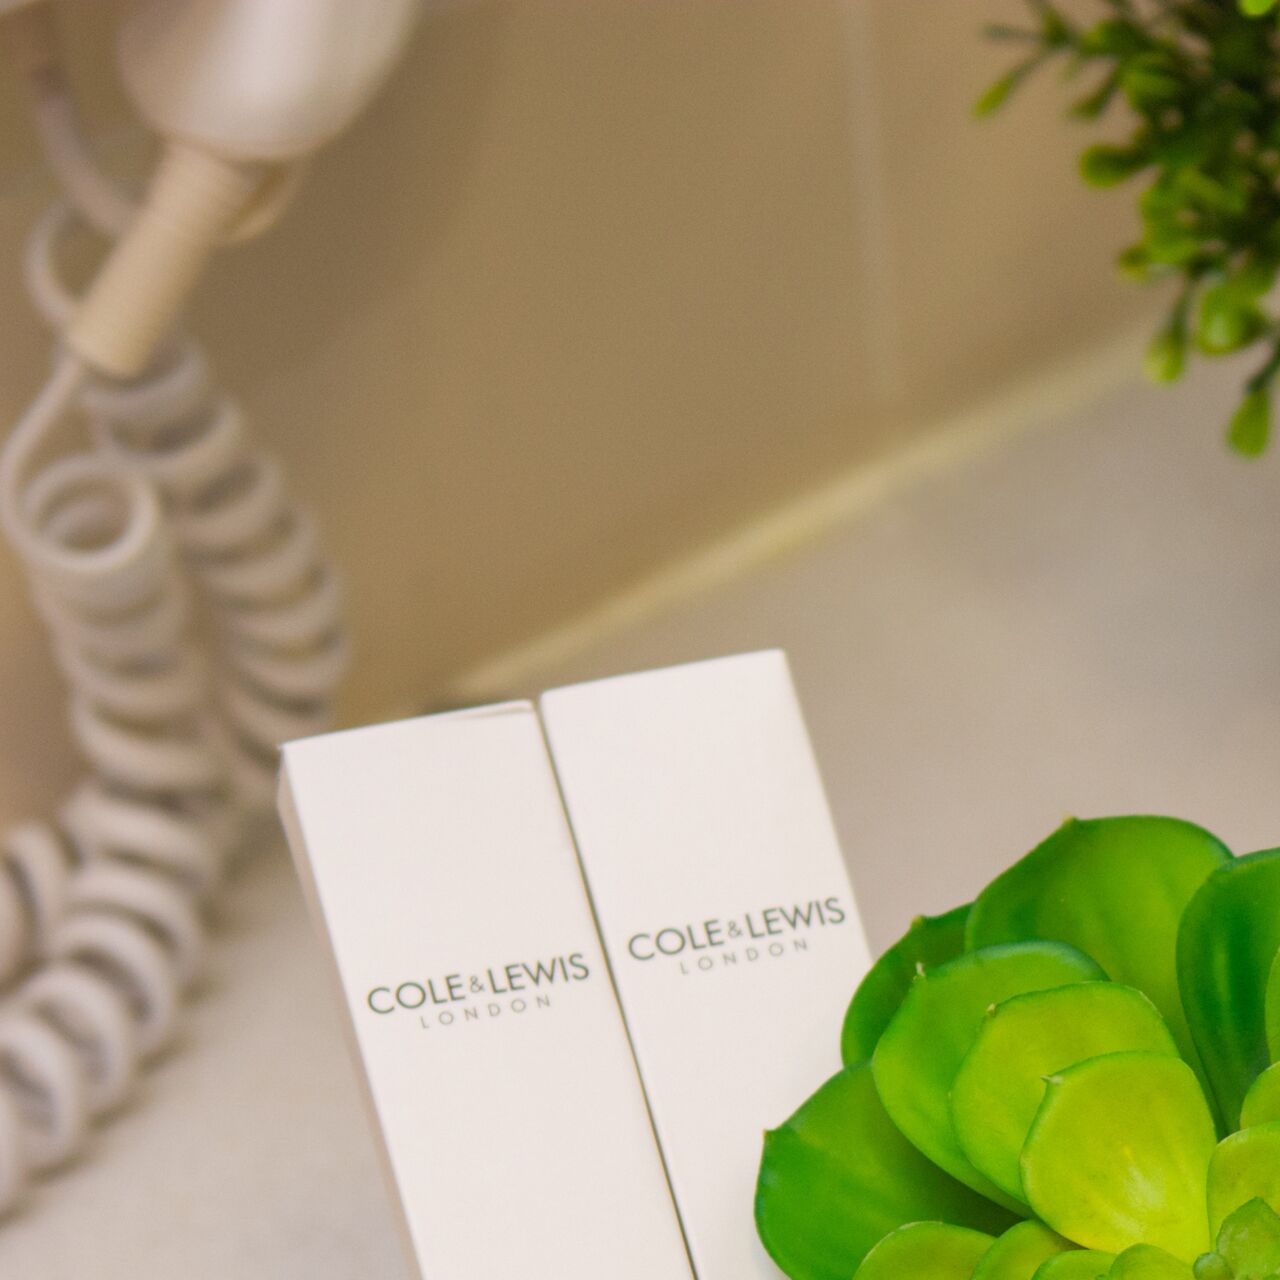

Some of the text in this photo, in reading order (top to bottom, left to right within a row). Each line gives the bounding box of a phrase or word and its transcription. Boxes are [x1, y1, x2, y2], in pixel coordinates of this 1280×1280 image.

[628, 897, 845, 961] COLE&LEWIS
[679, 938, 808, 975] LONDON
[367, 953, 589, 1015] COLE&LEWIS
[420, 994, 550, 1029] LONDON
